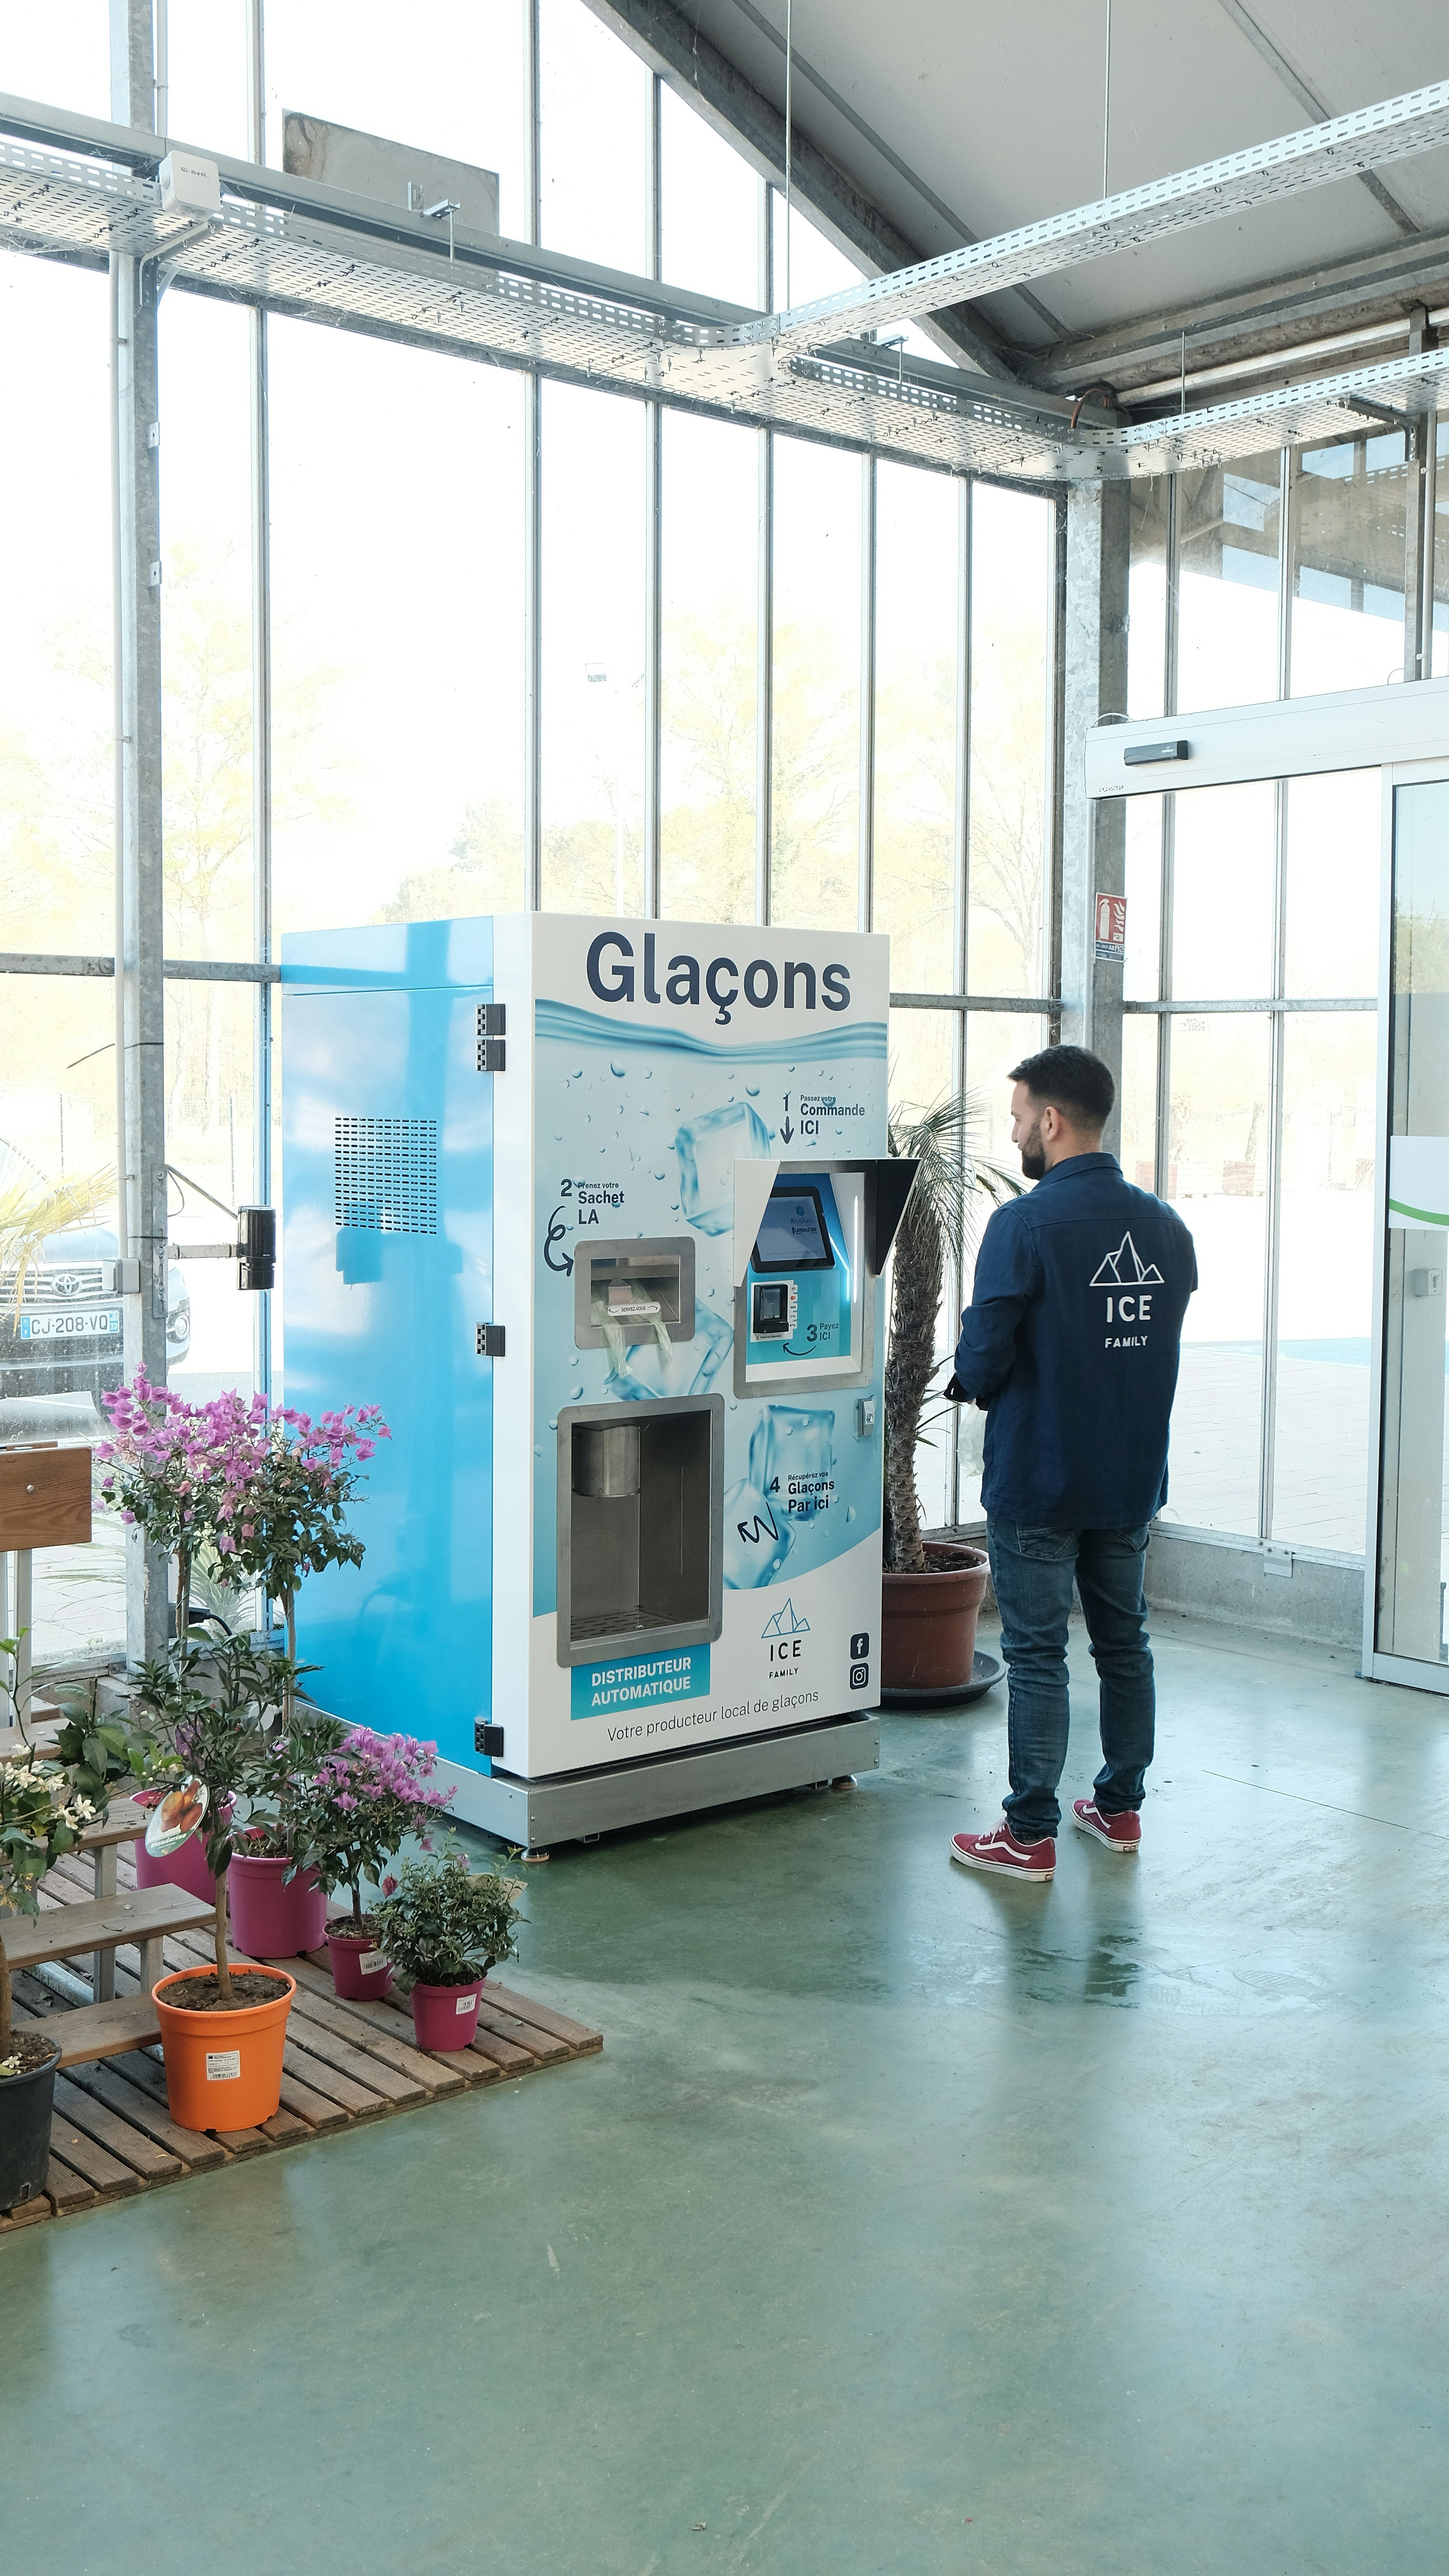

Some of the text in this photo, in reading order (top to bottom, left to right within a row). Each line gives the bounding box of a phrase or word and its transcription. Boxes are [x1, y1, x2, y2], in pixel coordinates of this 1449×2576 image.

[586, 931, 851, 1025] Glaçons
[783, 1095, 788, 1112] 1
[800, 1103, 865, 1115] Commande
[800, 1120, 818, 1134] ICI
[561, 1179, 572, 1197] 2
[578, 1190, 624, 1204] Sachet
[579, 1209, 599, 1224] LA
[1106, 1295, 1152, 1323] ICE
[31, 1315, 108, 1334] CJ-208-VQ
[110, 1322, 118, 1331] 33
[806, 1324, 817, 1342] 3
[820, 1332, 830, 1340] ICI
[1105, 1336, 1148, 1348] FAMILY
[770, 1476, 780, 1493] 4
[788, 1473, 818, 1481] Récupérez
[788, 1481, 834, 1495] Glaçons
[788, 1495, 829, 1513] Par ici
[770, 1640, 802, 1662] ICE
[592, 1657, 691, 1686] DISTRIBUTEUR
[769, 1667, 799, 1679] FAMILY
[591, 1676, 691, 1707] AUTOMATIQUE
[607, 1691, 818, 1742] Votre producteur local de glaçons
[150, 1833, 186, 1848] Mandarino
